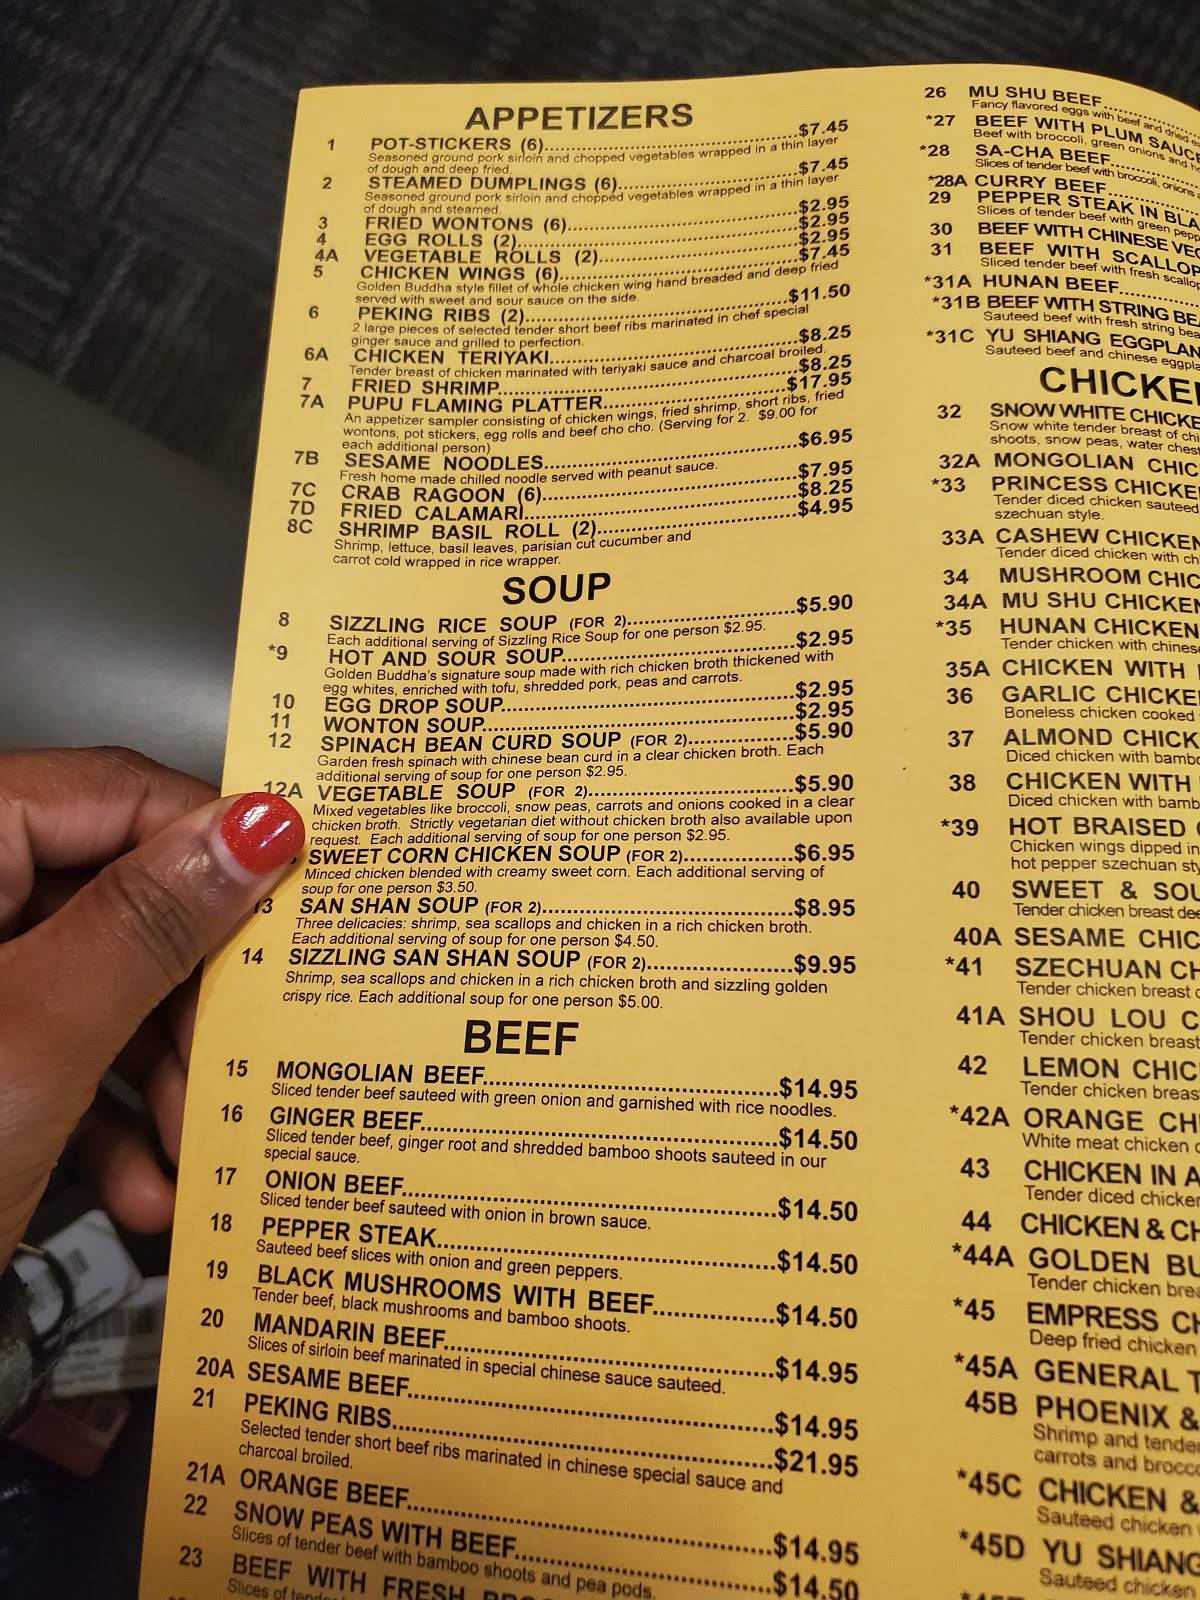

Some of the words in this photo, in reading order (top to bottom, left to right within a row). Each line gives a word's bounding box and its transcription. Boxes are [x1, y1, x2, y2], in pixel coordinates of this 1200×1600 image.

[924, 86, 946, 98] 26
[969, 85, 998, 97] MU
[1005, 86, 1046, 100] SHU
[465, 104, 692, 130] APPETIZERS
[328, 138, 334, 151] 1
[371, 137, 511, 150] POT-STICKERS
[368, 152, 428, 163] Seasoned
[431, 153, 473, 167] ground
[477, 153, 503, 167] pork
[508, 150, 542, 163] sirloin
[547, 153, 569, 163] and
[573, 152, 625, 164] chopped
[629, 150, 694, 162] vegetables
[698, 145, 750, 158] wrapped
[755, 144, 765, 153] in
[770, 144, 777, 152] a
[781, 140, 803, 150] thin
[808, 137, 838, 148] layer
[975, 144, 1054, 159] SA-CHA
[367, 164, 379, 173] of
[381, 164, 419, 175] dough
[422, 164, 445, 174] and
[449, 164, 479, 176] deep
[482, 164, 511, 174] fried.
[983, 274, 1058, 288] HUNAN
[304, 347, 328, 361] 6A
[354, 348, 444, 364] CHICKEN
[350, 365, 392, 376] Tender
[396, 366, 434, 377] breast
[438, 367, 451, 377] of
[454, 368, 501, 378] chicken
[506, 366, 568, 378] marinated
[572, 365, 597, 376] with
[602, 362, 645, 374] teriyaki
[650, 360, 687, 371] sauce
[692, 355, 715, 367] and
[720, 349, 774, 364] charcoal
[779, 343, 825, 360] broiled.
[1040, 367, 1200, 404] CHICKE
[294, 450, 318, 465] 7B
[345, 454, 430, 470] SESAME
[340, 470, 375, 481] Fresh
[381, 472, 416, 483] home
[421, 474, 456, 484] made
[460, 474, 500, 484] chilled
[505, 473, 547, 484] noodle
[551, 470, 593, 482] served
[598, 468, 623, 479] with
[627, 464, 671, 480] peanut
[676, 462, 717, 473] sauce.
[993, 494, 1042, 505] Tender
[1047, 495, 1084, 505] diced
[1090, 496, 1141, 508] chicken
[1146, 501, 1199, 513] sauteed
[995, 508, 1062, 519] szechuan
[1067, 509, 1103, 522] style.
[287, 518, 312, 534] 8C
[339, 521, 419, 538] SHRIMP
[432, 524, 492, 540] BASIL
[505, 523, 559, 539] ROLL
[942, 529, 984, 545] 33A
[996, 527, 1099, 543] CASHEW
[502, 572, 610, 604] SOUP
[1000, 617, 1085, 634] HUNAN
[1094, 618, 1199, 638] CHICKEN
[329, 648, 374, 665] HOT
[382, 651, 426, 666] AND
[437, 650, 495, 666] SOUR
[323, 684, 347, 696] egg
[352, 683, 397, 696] whites,
[402, 684, 458, 695] enriched
[462, 683, 487, 694] with
[491, 681, 518, 694] tofu,
[524, 679, 584, 692] shredded
[589, 677, 620, 692] pork,
[626, 678, 657, 690] peas
[662, 673, 687, 686] and
[692, 671, 741, 684] carrots.
[948, 729, 973, 747] 37
[1003, 728, 1112, 745] ALMOND
[263, 781, 303, 797] 12A
[317, 784, 443, 802] VEGETABLE
[456, 782, 515, 799] SOUP
[528, 785, 564, 800] (FOR
[301, 885, 333, 896] soup
[337, 882, 355, 894] for
[358, 884, 382, 894] one
[386, 884, 432, 896] person
[436, 880, 477, 893] $3.50.
[952, 880, 980, 898] 40
[1012, 880, 1103, 899] SWEET
[1120, 880, 1137, 899] &
[242, 947, 263, 964] 14
[289, 948, 385, 965] SIZZLING
[393, 948, 439, 966] SAN
[446, 949, 508, 966] SHAN
[516, 949, 580, 968] SOUP
[587, 955, 626, 971] (FOR
[1016, 957, 1161, 978] SZECHUAN
[464, 1019, 579, 1055] BEEF
[226, 1059, 248, 1077] 15
[277, 1061, 413, 1082] MONGOLIAN
[1022, 1132, 1071, 1148] White
[1076, 1137, 1119, 1150] meat
[1124, 1136, 1189, 1152] chicken
[260, 1191, 301, 1207] Sliced
[305, 1195, 349, 1210] tender
[353, 1197, 385, 1213] beef
[388, 1202, 446, 1217] sauteed
[451, 1205, 480, 1219] with
[485, 1209, 525, 1222] onion
[531, 1212, 543, 1223] in
[549, 1209, 595, 1226] brown
[601, 1216, 650, 1229] sauce.
[207, 1259, 228, 1279] 19
[258, 1264, 334, 1289] BLACK
[344, 1272, 501, 1298] MUSHROOMS
[513, 1284, 575, 1308] WITH
[1027, 1302, 1159, 1331] EMPRESS
[192, 1387, 214, 1408] 21
[244, 1393, 328, 1421] PEKING
